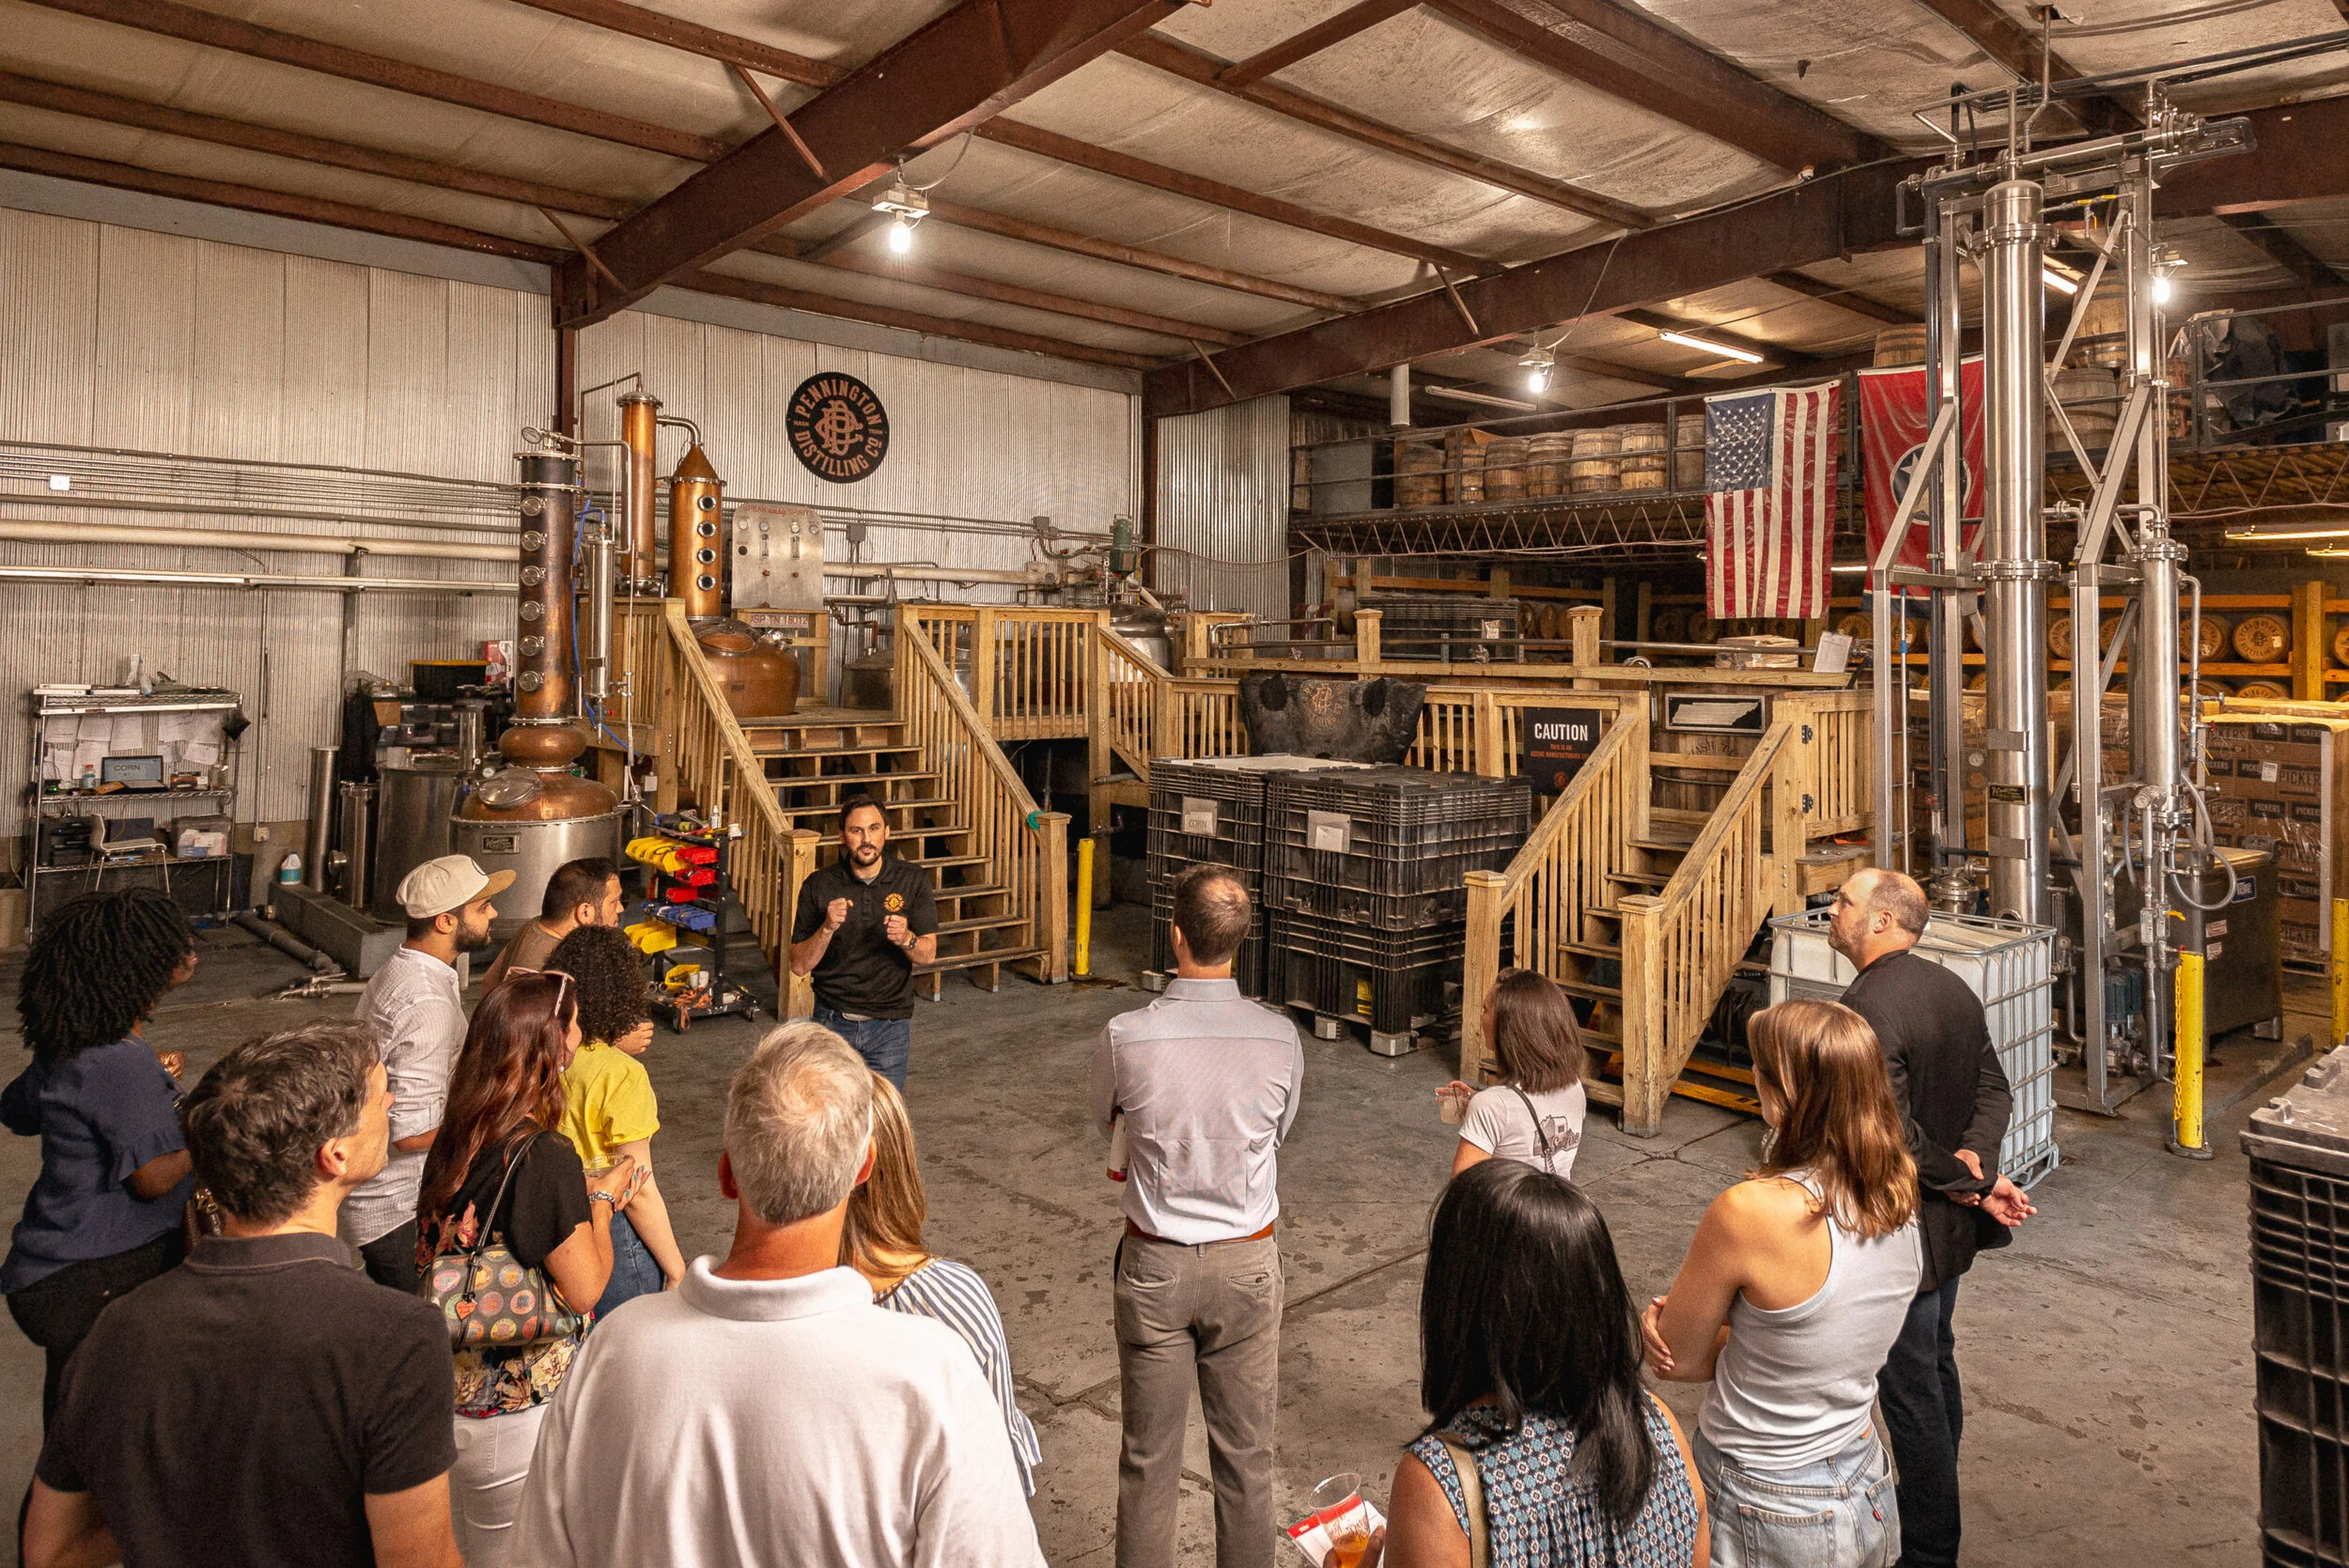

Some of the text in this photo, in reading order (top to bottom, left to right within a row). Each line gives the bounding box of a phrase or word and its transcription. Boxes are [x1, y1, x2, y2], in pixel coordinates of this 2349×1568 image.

[795, 379, 882, 426] PENNINGTON
[794, 430, 869, 476] DISTILLING
[786, 509, 814, 518] SPIRITS
[769, 615, 781, 625] TN
[1534, 722, 1588, 741] CAUTION
[2279, 769, 2321, 786] PICKER
[2255, 802, 2280, 813] PICKERS
[1189, 818, 1207, 829] CORN
